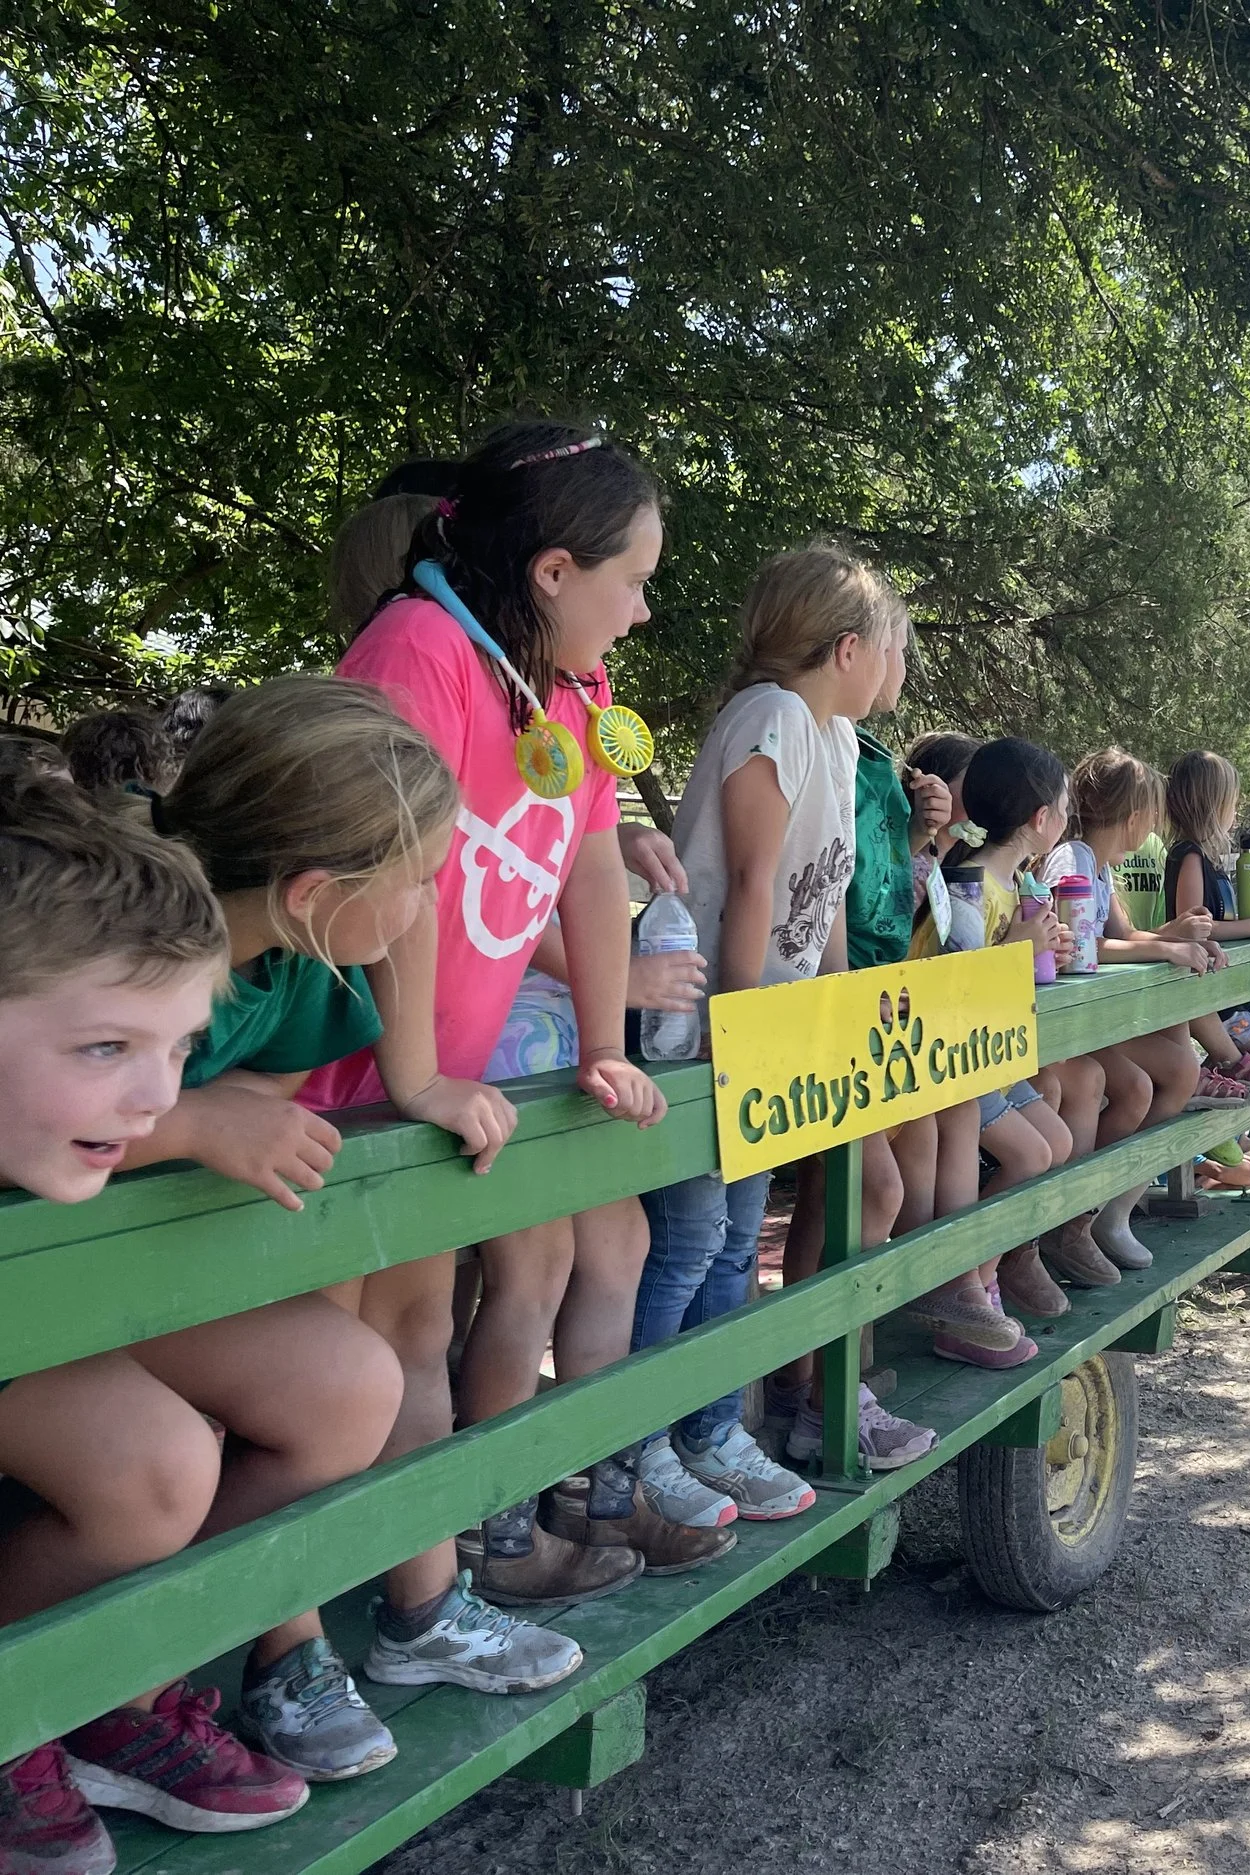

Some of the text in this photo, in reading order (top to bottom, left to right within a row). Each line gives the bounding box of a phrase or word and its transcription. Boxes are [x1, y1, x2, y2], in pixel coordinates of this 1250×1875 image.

[1122, 872, 1162, 892] STARS
[739, 1025, 1028, 1144] Cathy's Critters
